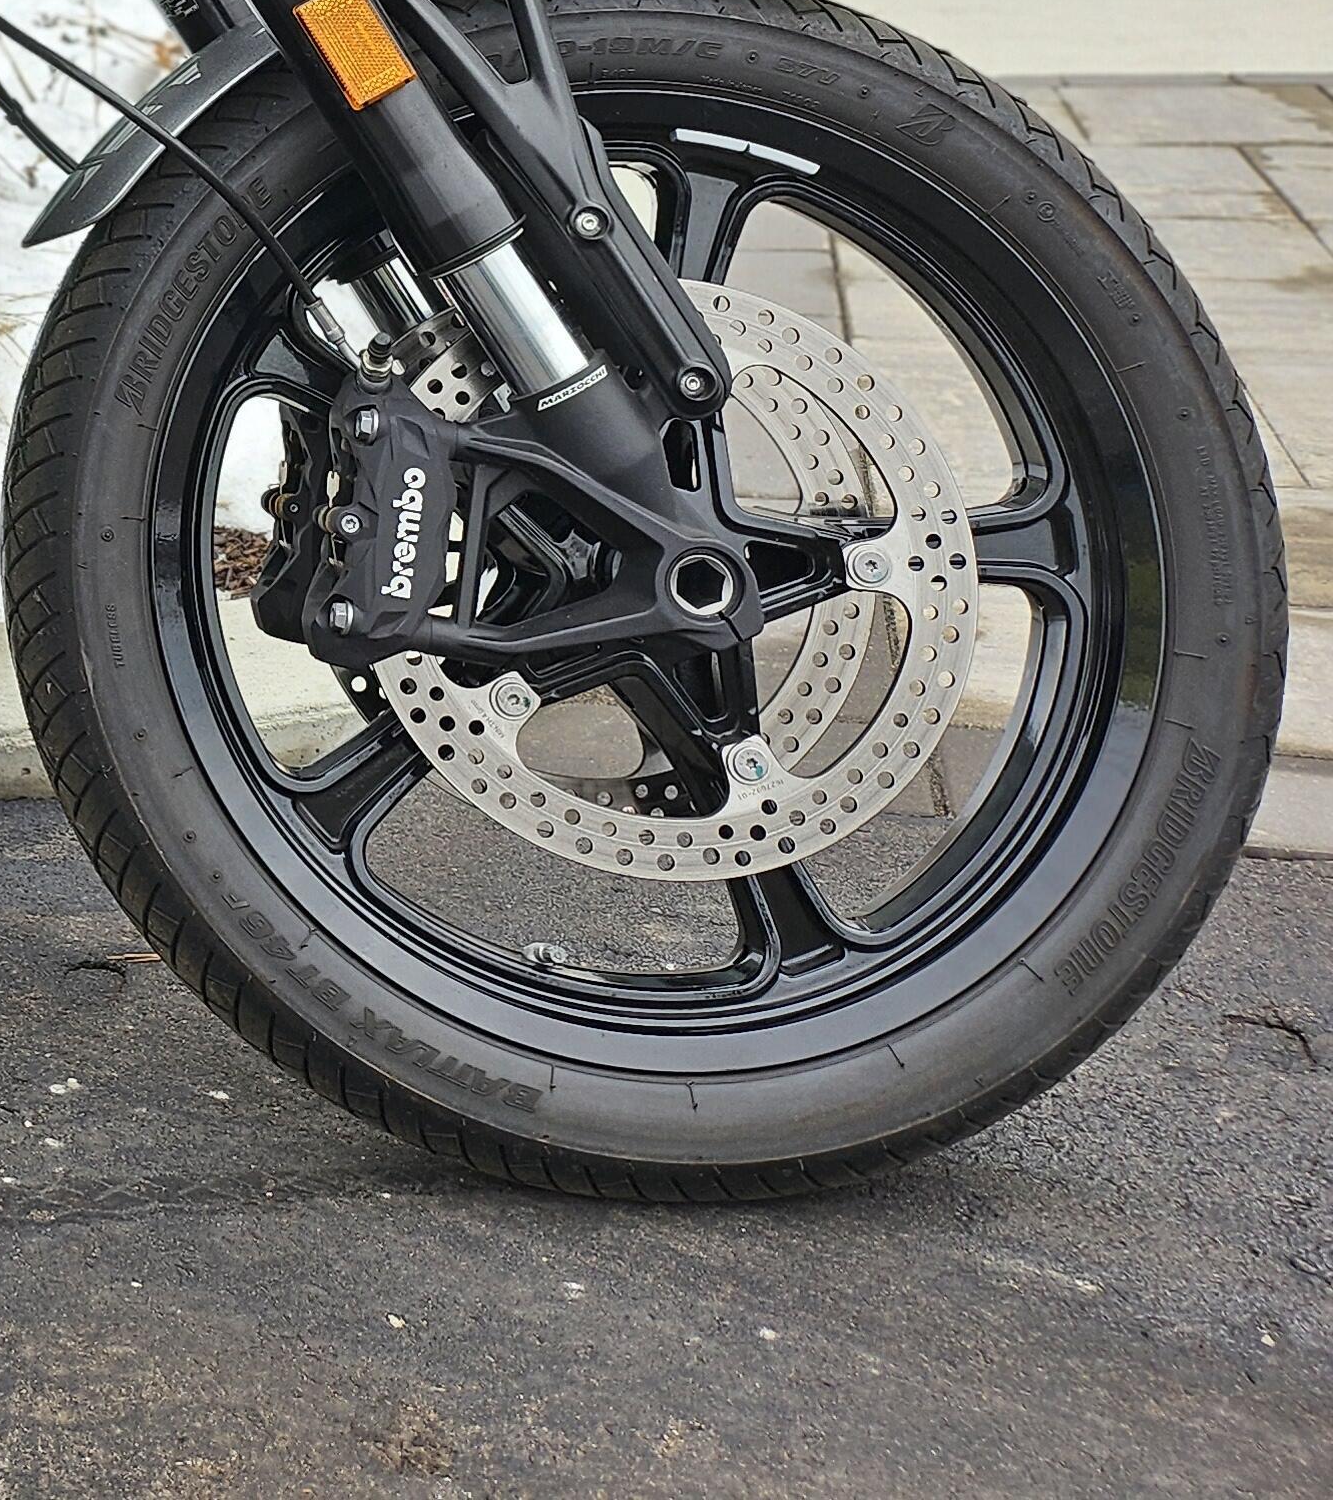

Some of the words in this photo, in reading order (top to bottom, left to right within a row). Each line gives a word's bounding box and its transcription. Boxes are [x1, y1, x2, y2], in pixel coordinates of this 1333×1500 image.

[541, 368, 606, 408] MARZOCCHI
[381, 467, 426, 599] brembo
[1053, 738, 1222, 994] BRIDGESTONE
